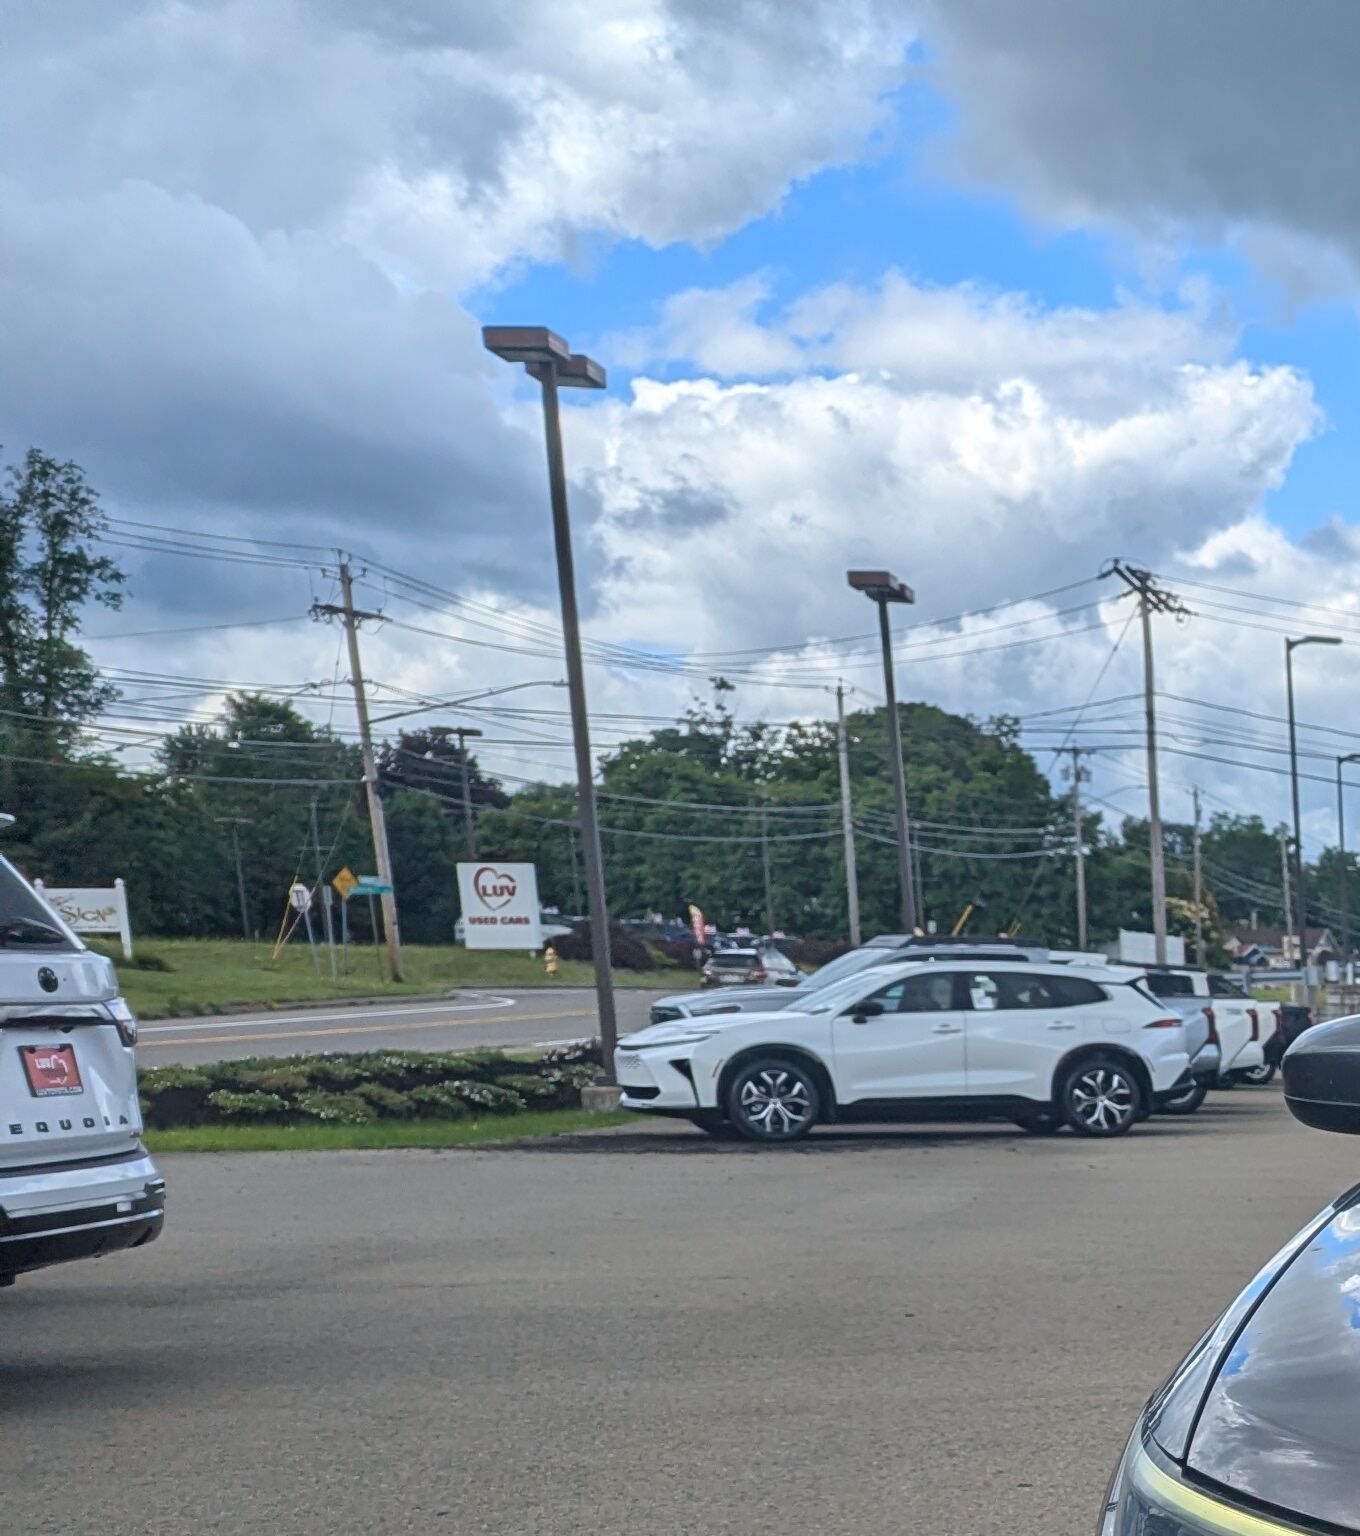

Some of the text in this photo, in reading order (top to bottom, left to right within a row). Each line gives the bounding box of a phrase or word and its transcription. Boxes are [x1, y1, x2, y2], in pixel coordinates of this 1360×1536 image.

[481, 885, 517, 897] LUV
[468, 916, 530, 925] USED CARS
